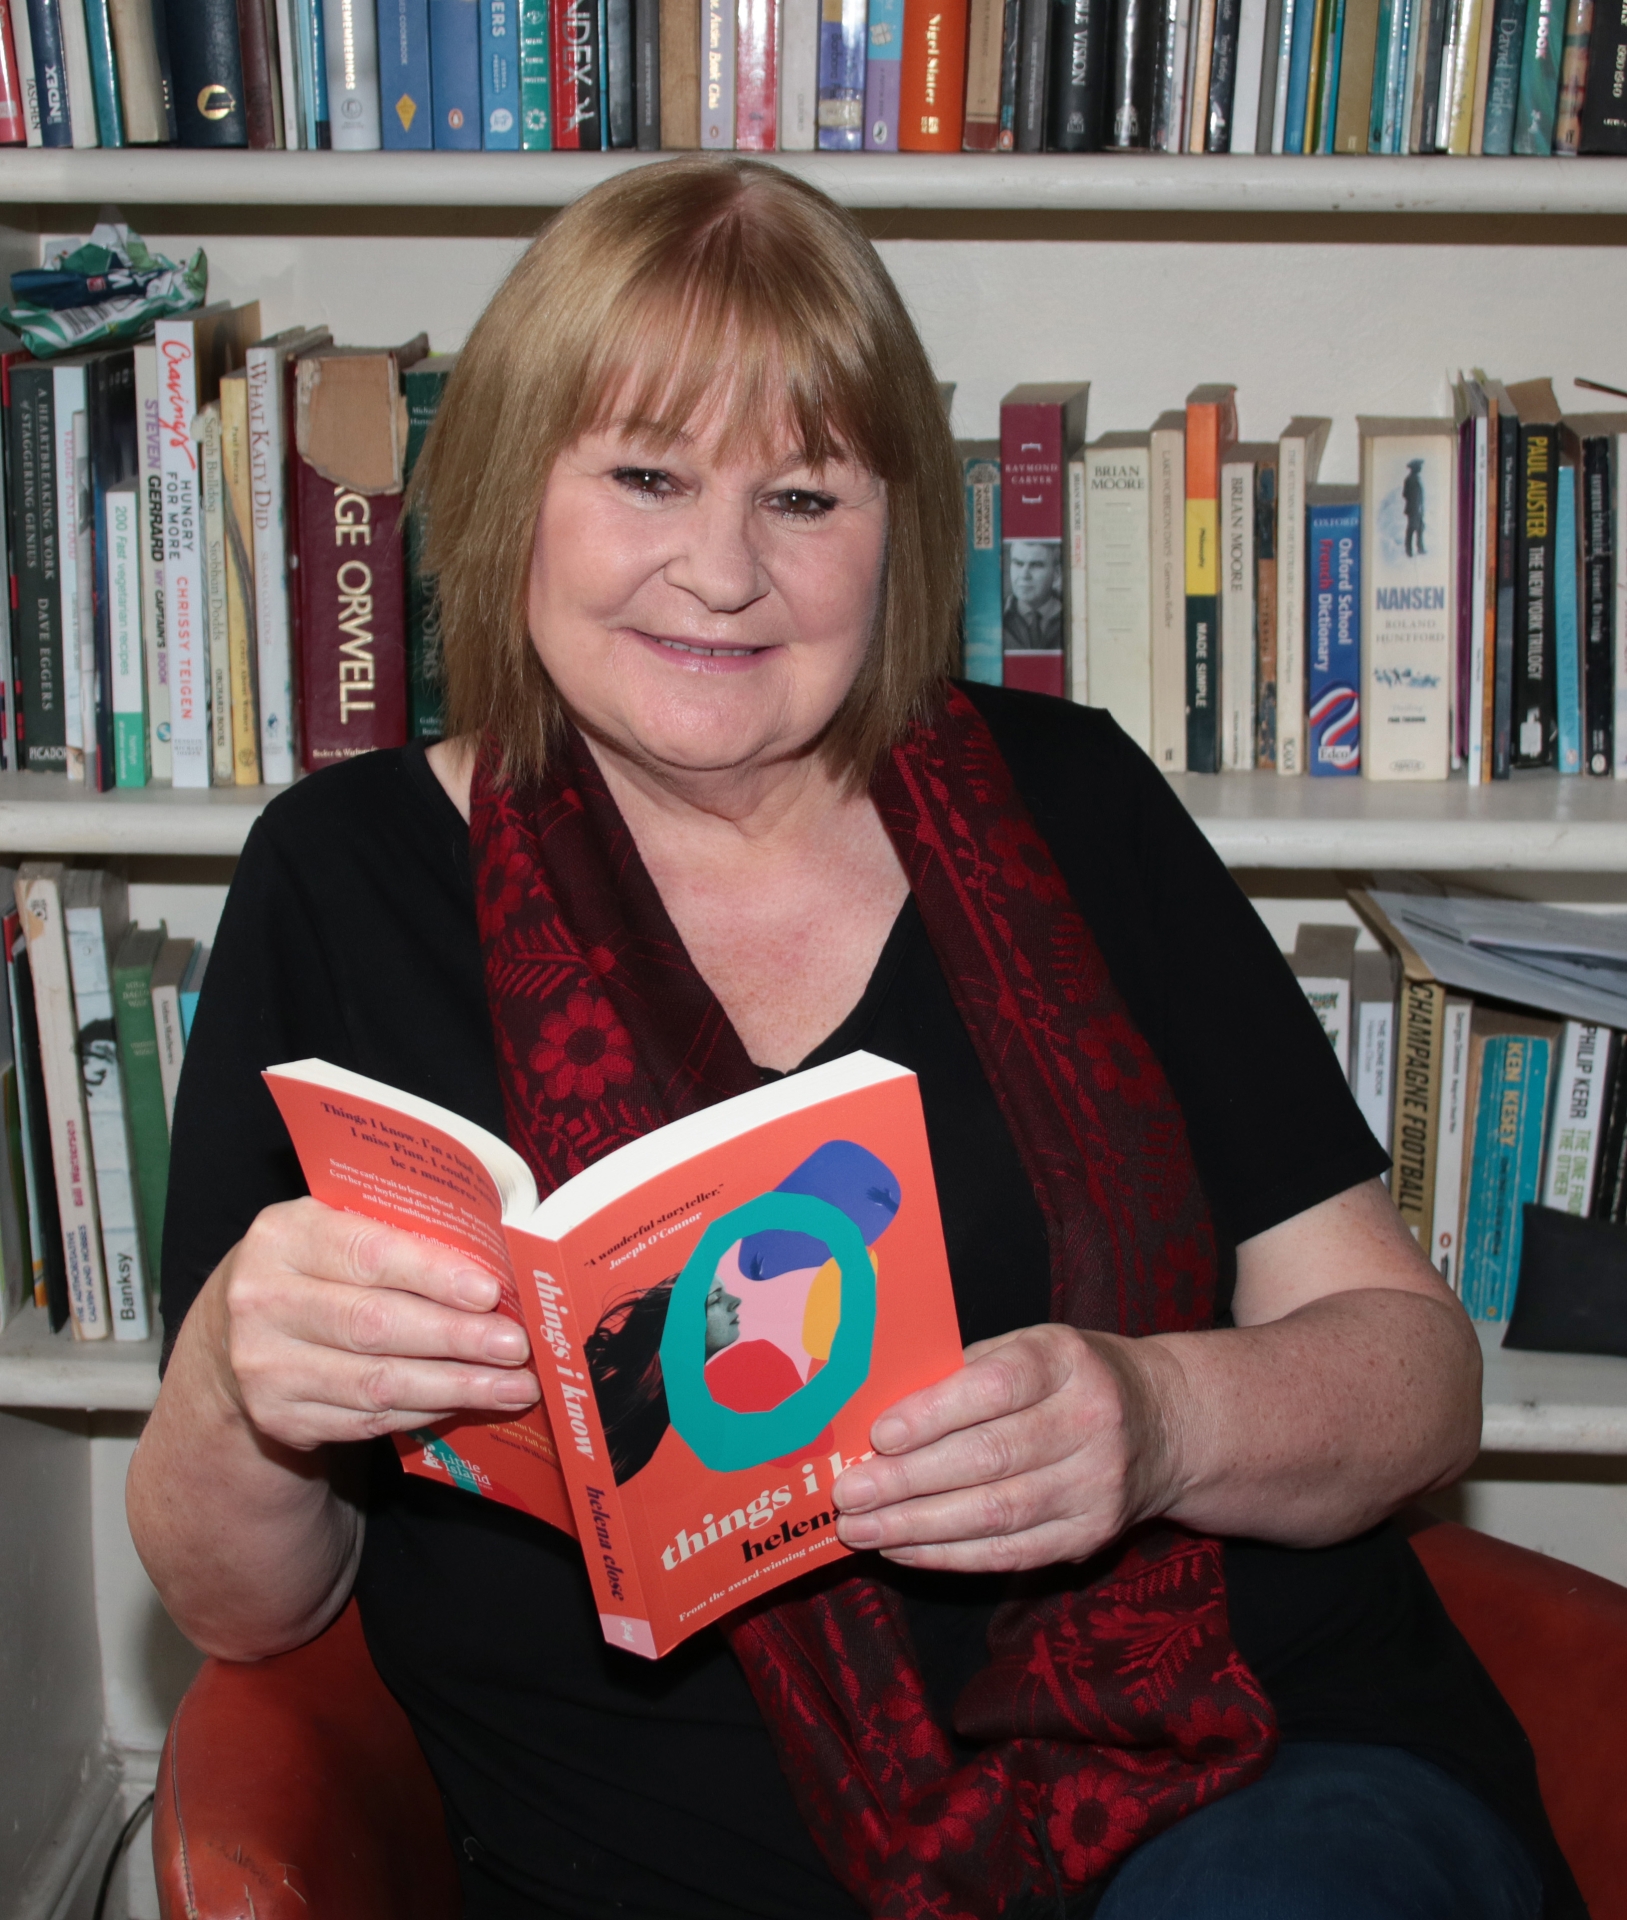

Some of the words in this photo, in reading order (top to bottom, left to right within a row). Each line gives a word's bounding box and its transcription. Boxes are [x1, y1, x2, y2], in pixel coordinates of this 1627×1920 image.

[926, 14, 942, 55] Nigel
[1494, 18, 1520, 70] David
[1535, 16, 1551, 60] BOOK
[1071, 30, 1088, 87] VISION
[924, 58, 940, 106] Slater
[37, 388, 48, 398] A
[158, 340, 197, 470] Cravings
[145, 398, 161, 469] STEVEN
[203, 417, 218, 457] Sarah
[21, 413, 36, 508] STAGGERING
[38, 403, 54, 529] HEARTBREAKING
[1005, 463, 1059, 474] RAYMOND
[1094, 465, 1140, 477] BRIAN
[1526, 436, 1548, 477] PAUL
[167, 471, 180, 504] FOR
[204, 459, 220, 513] Bulldog
[1010, 475, 1053, 485] CARVER
[1090, 478, 1146, 491] MOORE
[1230, 477, 1243, 528] BRIAN
[114, 506, 128, 532] 200
[147, 474, 166, 563] GERRARD
[181, 480, 195, 552] HUNGRY
[333, 486, 371, 546] GE
[1526, 479, 1548, 539] AUSTER
[25, 513, 39, 568] GENIUS
[43, 535, 57, 580] WORK
[116, 535, 128, 560] Fast
[169, 512, 181, 560] MORE
[1528, 545, 1545, 569] THE
[207, 540, 224, 594] Siobhan
[1230, 532, 1243, 592] MOORE
[1318, 538, 1335, 590] French
[1338, 537, 1354, 591] Oxford
[1528, 570, 1545, 598] NEW
[115, 562, 131, 626] vegetarian
[177, 576, 192, 651] CHRISSY
[1376, 585, 1445, 611] NANSEN
[1528, 599, 1544, 632] YORK
[38, 598, 51, 641] DAVE
[155, 589, 167, 649] CAPTAIN'S
[211, 598, 225, 641] Dodds
[1195, 622, 1208, 660] MADE
[1313, 592, 1333, 673] Dictionary
[1337, 593, 1354, 646] School
[1376, 632, 1446, 644] HUNTFORD
[1385, 619, 1436, 630] ROLAND
[117, 630, 133, 676] recipes
[336, 560, 376, 725] ORWELL
[1527, 631, 1544, 681] TRILOGY
[41, 646, 53, 712] EGGERS
[157, 651, 168, 685] BOOK
[181, 658, 194, 720] TEIGEN
[1195, 662, 1208, 709] SIMPLE
[214, 668, 226, 714] ORCHARD
[216, 716, 227, 747] BOOKS
[1320, 748, 1350, 760] Edco
[1404, 983, 1435, 1112] CHAMPAGNE
[1503, 1040, 1525, 1082] KEN
[1575, 1024, 1599, 1075] PHILIP
[1499, 1089, 1522, 1149] KESEY
[1568, 1077, 1592, 1119] KERR
[320, 1101, 368, 1126] Things
[370, 1118, 377, 1129] I
[379, 1120, 419, 1145] know.
[420, 1137, 443, 1156] I'm
[351, 1126, 358, 1138] I
[361, 1132, 390, 1149] miss
[392, 1141, 428, 1164] Finn.
[1558, 1127, 1576, 1151] THE
[1573, 1128, 1592, 1152] THE
[329, 1158, 360, 1175] Saoirse
[379, 1177, 398, 1188] wait
[347, 1174, 362, 1186] her
[389, 1155, 406, 1170] be
[409, 1165, 417, 1175] a
[1399, 1112, 1428, 1212] FOOTBALL
[1553, 1154, 1572, 1197] OTHER
[1571, 1155, 1588, 1181] ONE
[73, 1187, 84, 1207] Bill
[361, 1192, 379, 1204] and
[378, 1196, 393, 1209] her
[393, 1204, 431, 1223] rumbling
[598, 1220, 655, 1261] wonderful
[609, 1241, 647, 1270] Joseph
[116, 1252, 137, 1321] Banksy
[532, 1269, 572, 1360] things
[555, 1364, 585, 1381] i
[560, 1382, 596, 1462] know
[439, 1452, 481, 1474] Little
[444, 1463, 492, 1486] Island
[660, 1484, 793, 1571] things
[801, 1463, 820, 1496] i
[585, 1485, 612, 1550] helena
[603, 1554, 625, 1602] close
[678, 1600, 707, 1623] From
[708, 1588, 726, 1603] the
[727, 1548, 807, 1593] award-winning
